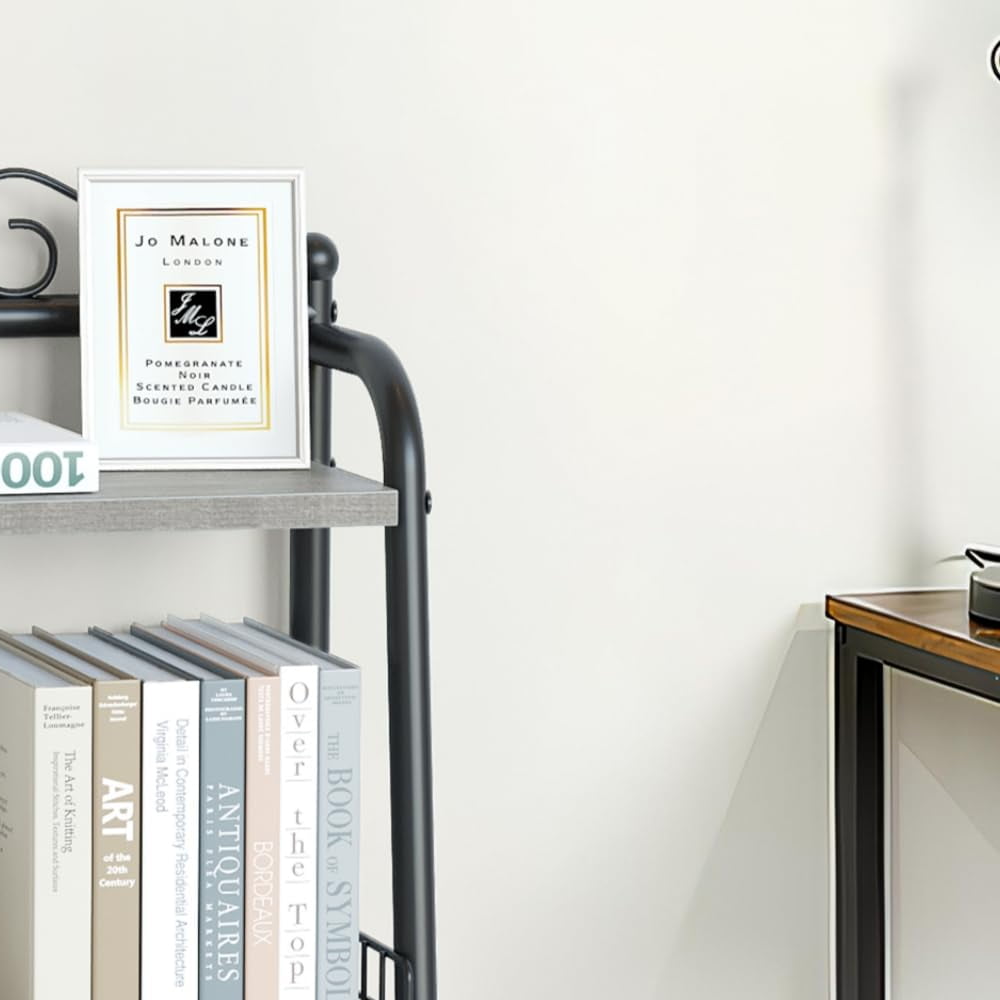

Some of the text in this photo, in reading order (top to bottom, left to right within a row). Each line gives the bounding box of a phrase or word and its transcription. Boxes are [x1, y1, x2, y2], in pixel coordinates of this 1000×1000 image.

[135, 234, 249, 247] JO MALONE
[162, 257, 223, 266] LONDON
[289, 682, 309, 776] Over
[327, 732, 339, 761] THE
[153, 720, 168, 813] Virginia McLeod
[62, 750, 76, 853] The Art of Knitting
[102, 778, 133, 841] ART
[206, 785, 214, 835] PARIS
[326, 768, 353, 848] BOOK
[103, 853, 131, 862] of the
[106, 865, 128, 874] 20th
[172, 719, 189, 988] Detail in Contemporary Residential Architecture
[291, 808, 305, 878] the
[326, 857, 339, 873] OF
[99, 878, 136, 888] Century
[212, 784, 240, 982] ANTIQUAIRES
[252, 841, 274, 945] BORDEAUX
[205, 904, 213, 981] MARKETS
